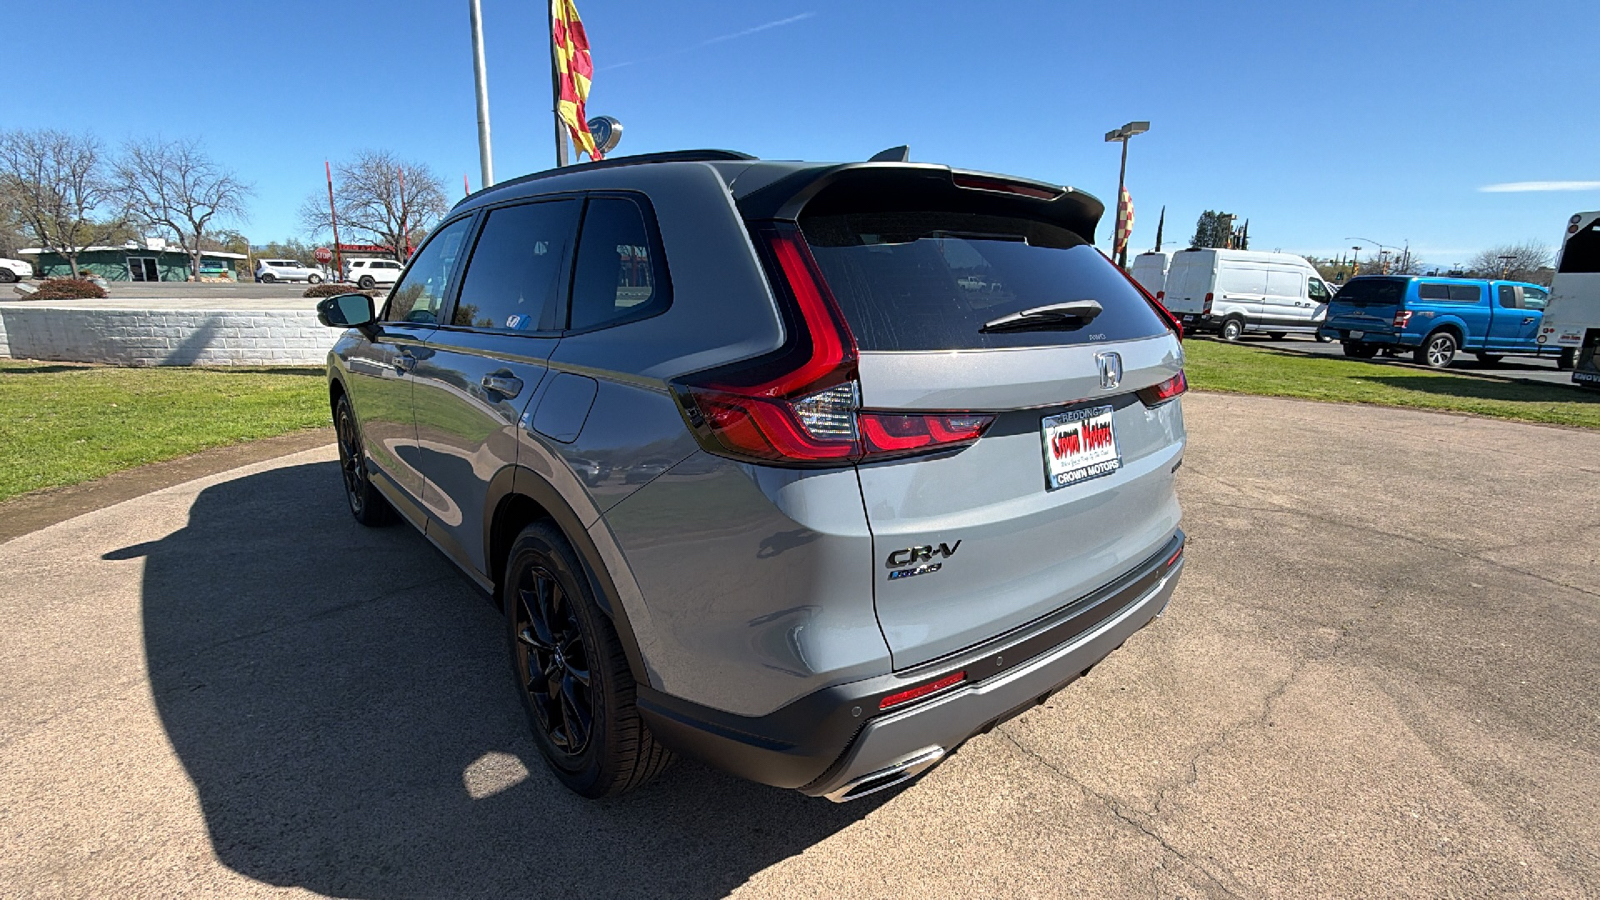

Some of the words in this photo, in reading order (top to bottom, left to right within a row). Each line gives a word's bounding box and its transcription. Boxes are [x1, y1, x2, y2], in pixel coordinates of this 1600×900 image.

[316, 251, 331, 259] STOP
[1088, 333, 1107, 341] AWD
[1062, 407, 1099, 423] REDDING
[1051, 427, 1081, 461] Crown
[1081, 418, 1112, 452] Motors
[1057, 467, 1088, 485] CROWN
[1087, 459, 1119, 476] MOTORS
[885, 539, 962, 569] CR-V
